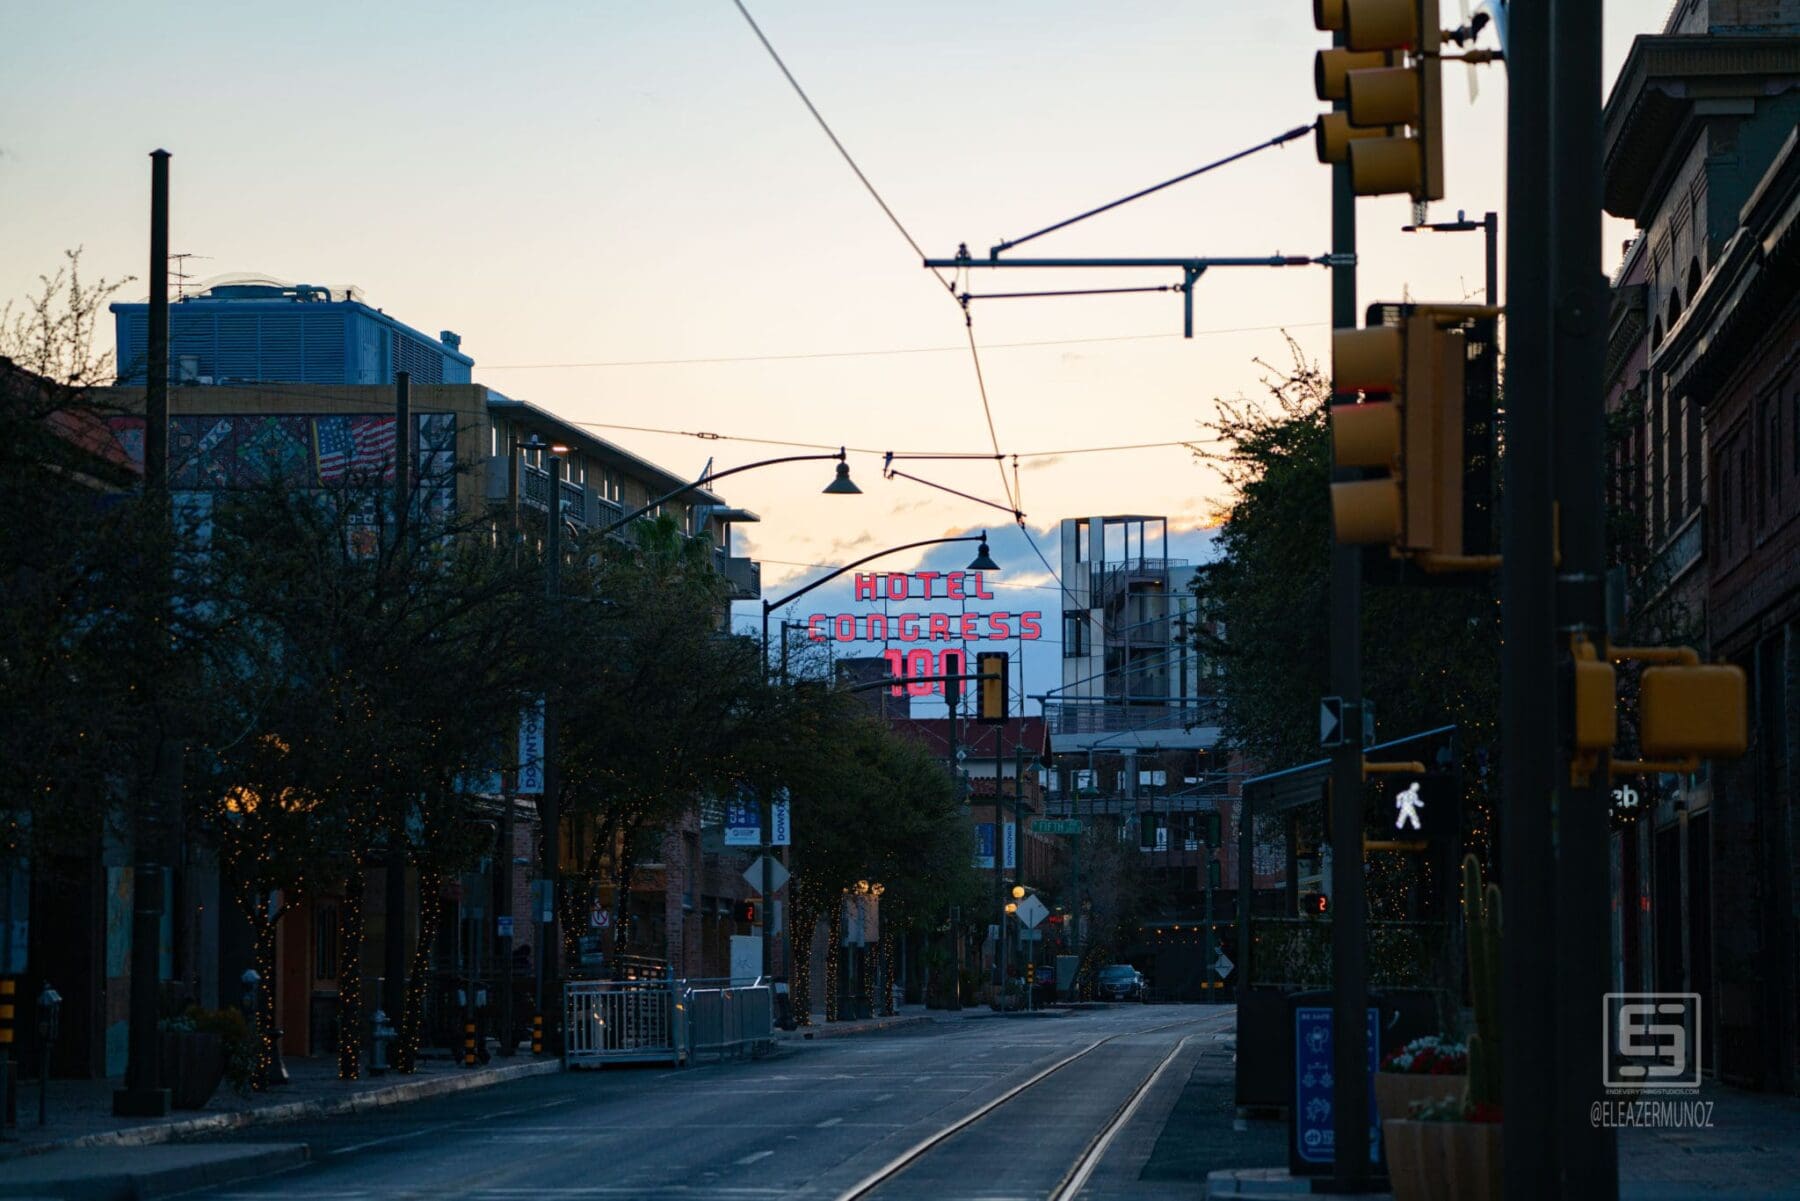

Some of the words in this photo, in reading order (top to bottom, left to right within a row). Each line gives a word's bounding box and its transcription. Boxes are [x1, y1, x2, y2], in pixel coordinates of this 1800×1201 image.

[855, 571, 994, 601] HOTEL
[808, 611, 1042, 642] CONGRESS
[1319, 897, 1327, 911] 2
